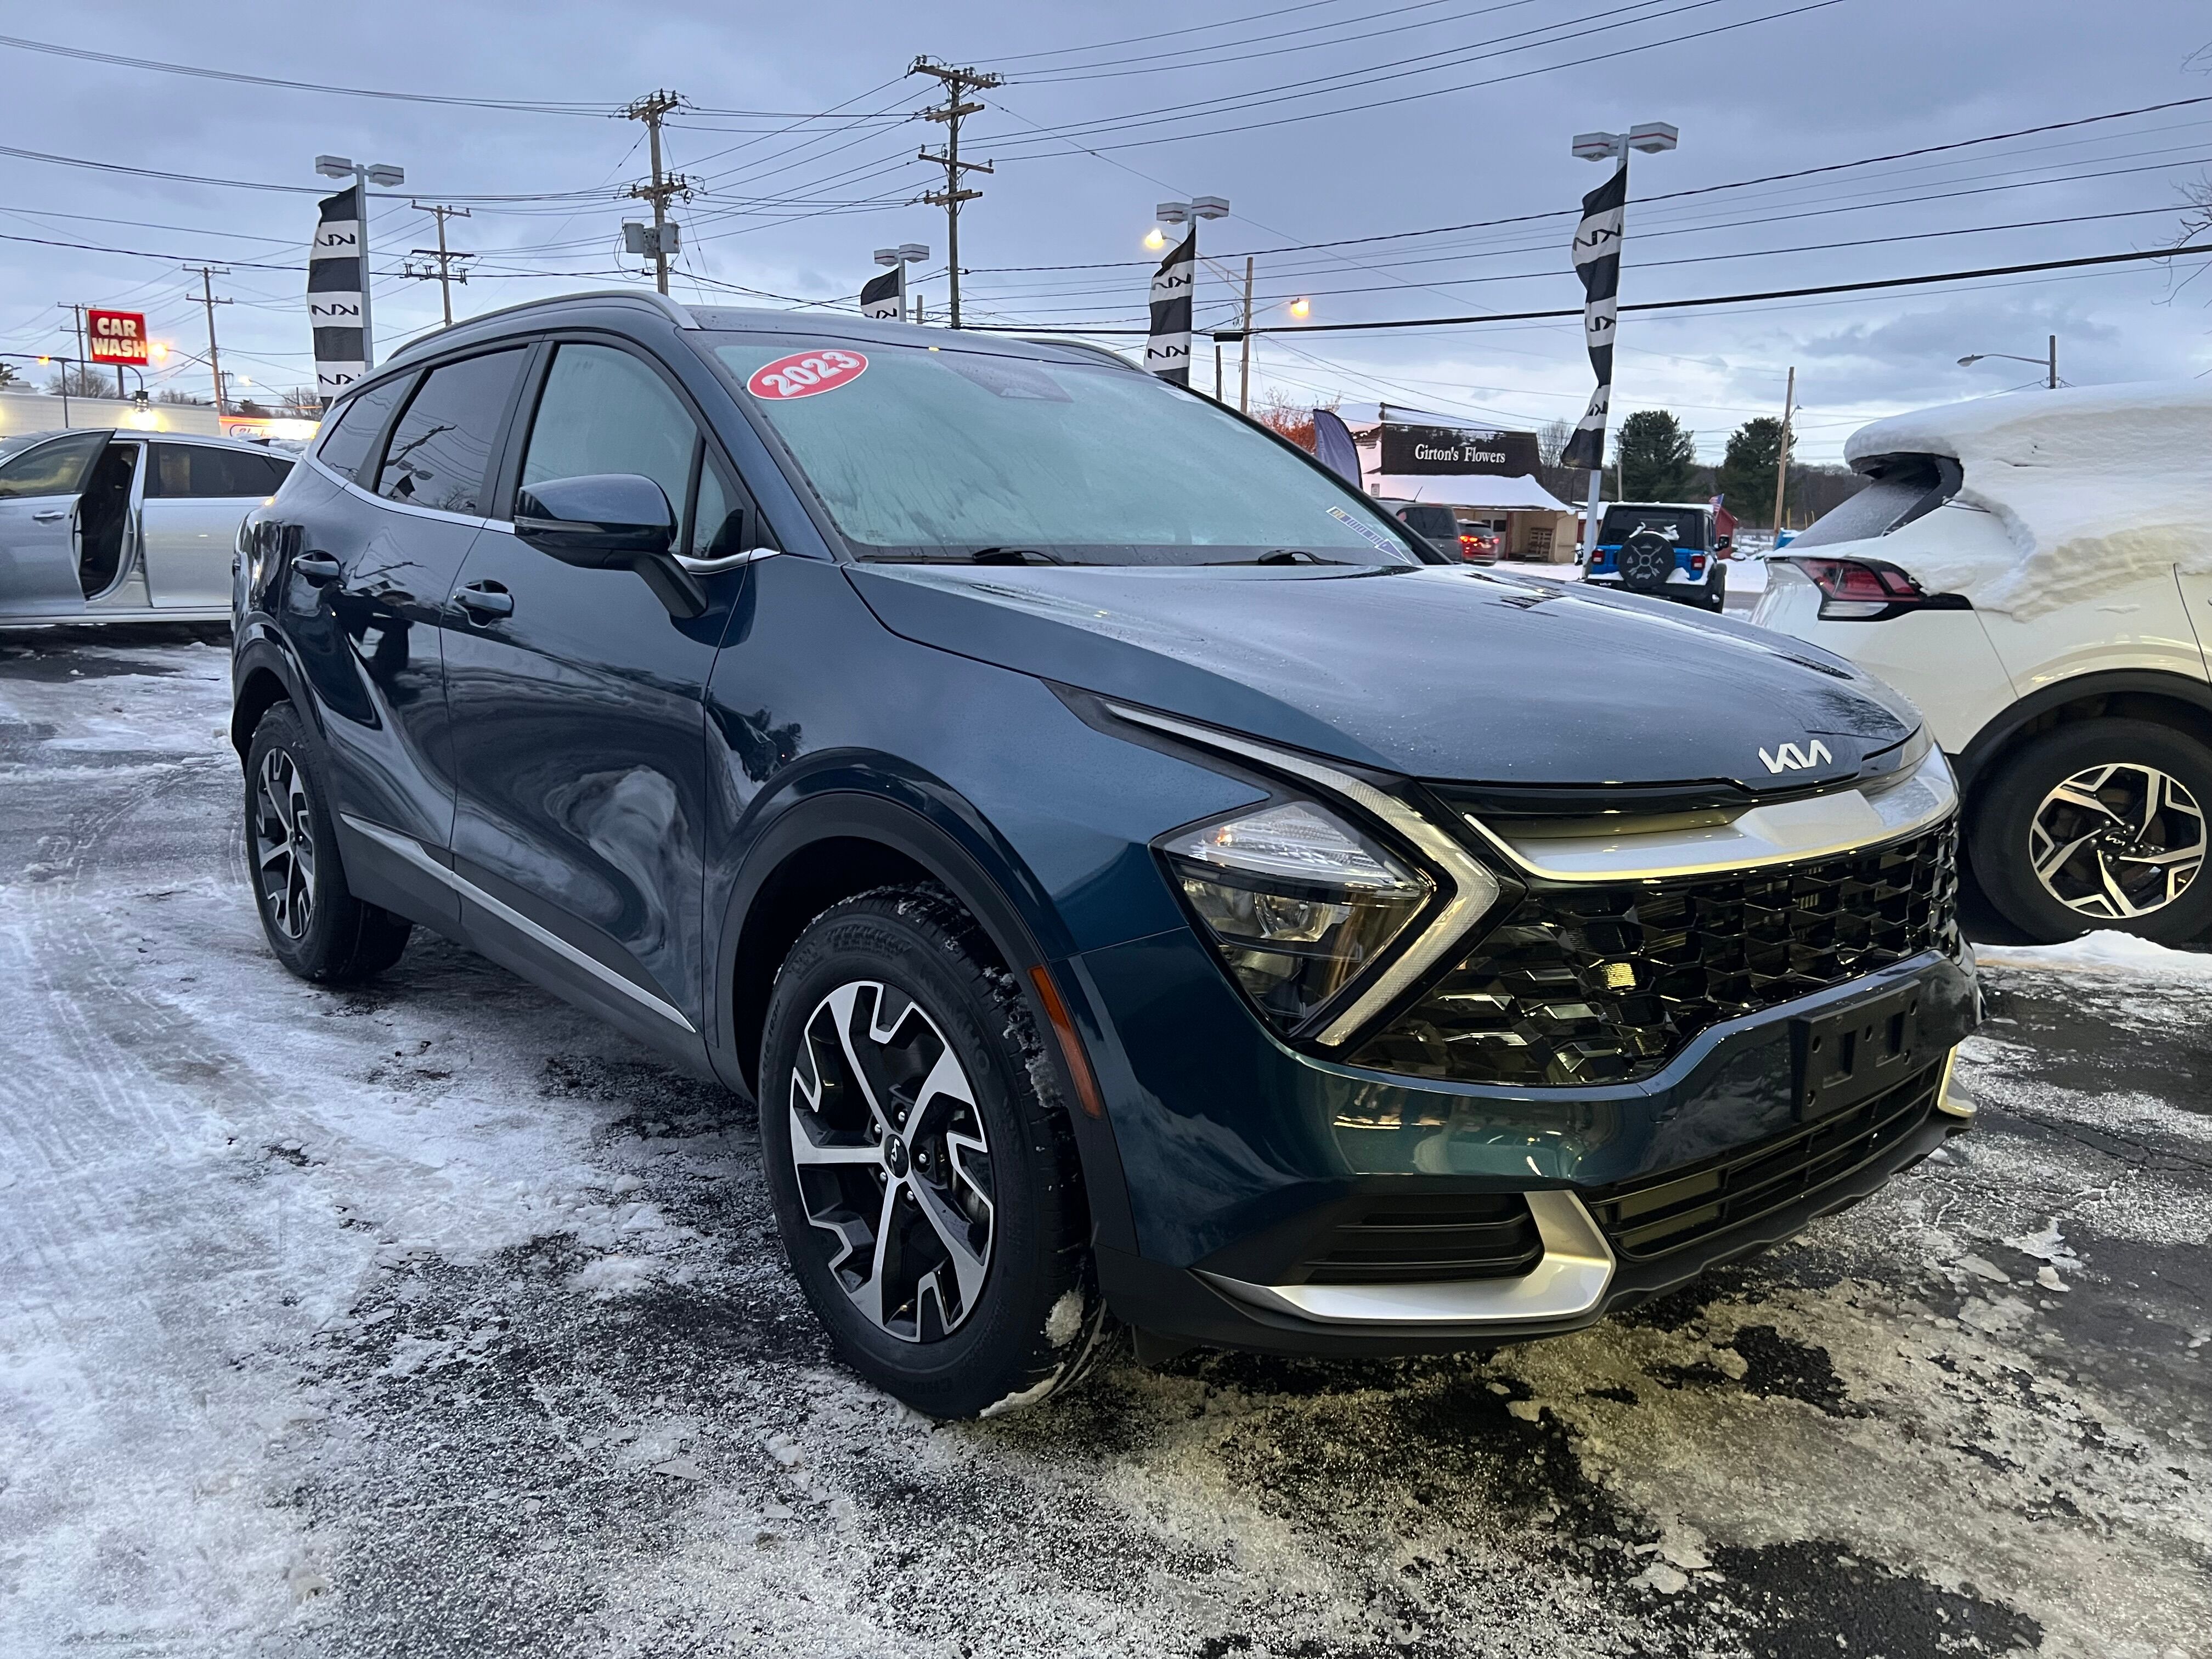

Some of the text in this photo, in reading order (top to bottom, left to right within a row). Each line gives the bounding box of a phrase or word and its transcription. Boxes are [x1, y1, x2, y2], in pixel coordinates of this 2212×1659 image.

[97, 317, 137, 337] CAR
[92, 337, 146, 358] WASH
[761, 352, 860, 396] 2023
[1415, 443, 1505, 463] Girton's Flowers
